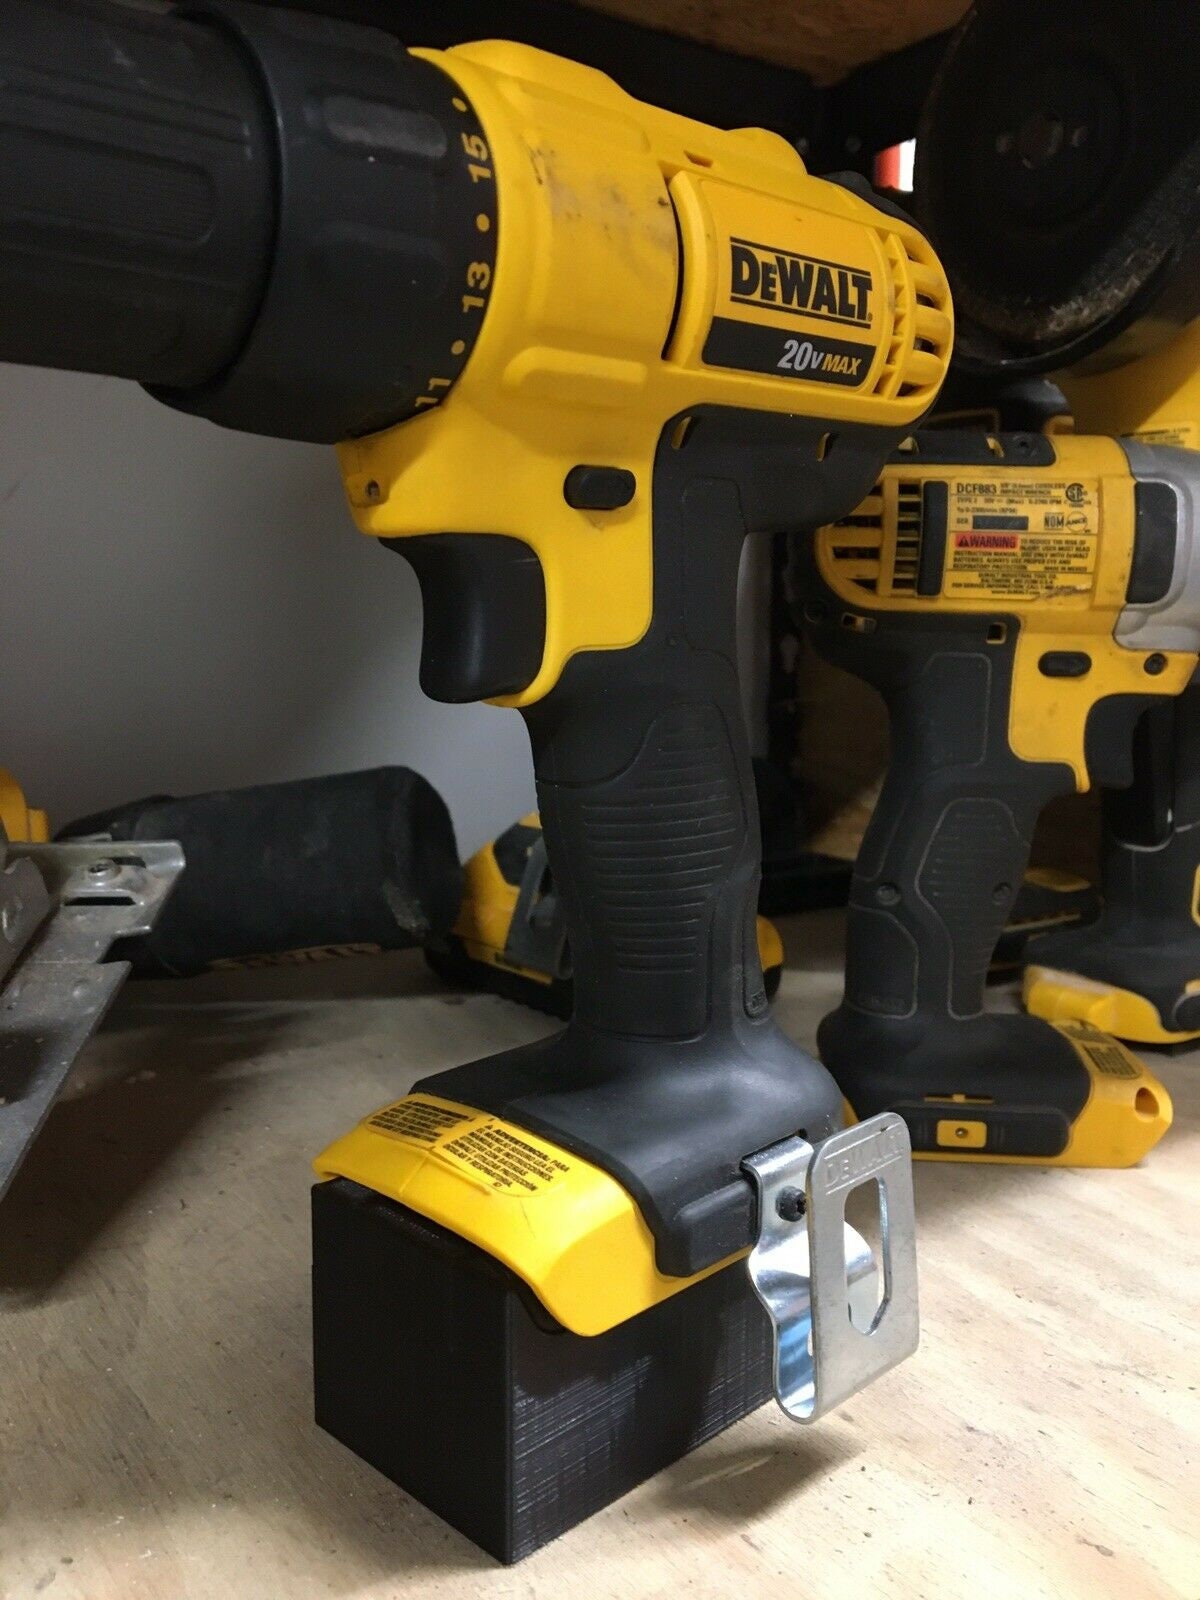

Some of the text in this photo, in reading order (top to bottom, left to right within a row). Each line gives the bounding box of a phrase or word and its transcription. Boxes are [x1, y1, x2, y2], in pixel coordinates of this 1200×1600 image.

[461, 133, 491, 183] 15
[462, 261, 491, 313] 13
[731, 242, 873, 322] DEWALT
[822, 353, 862, 376] MAX
[415, 377, 451, 407] 11
[957, 483, 997, 494] DCF883
[1044, 515, 1064, 527] NOM
[969, 536, 1016, 548] WARNING
